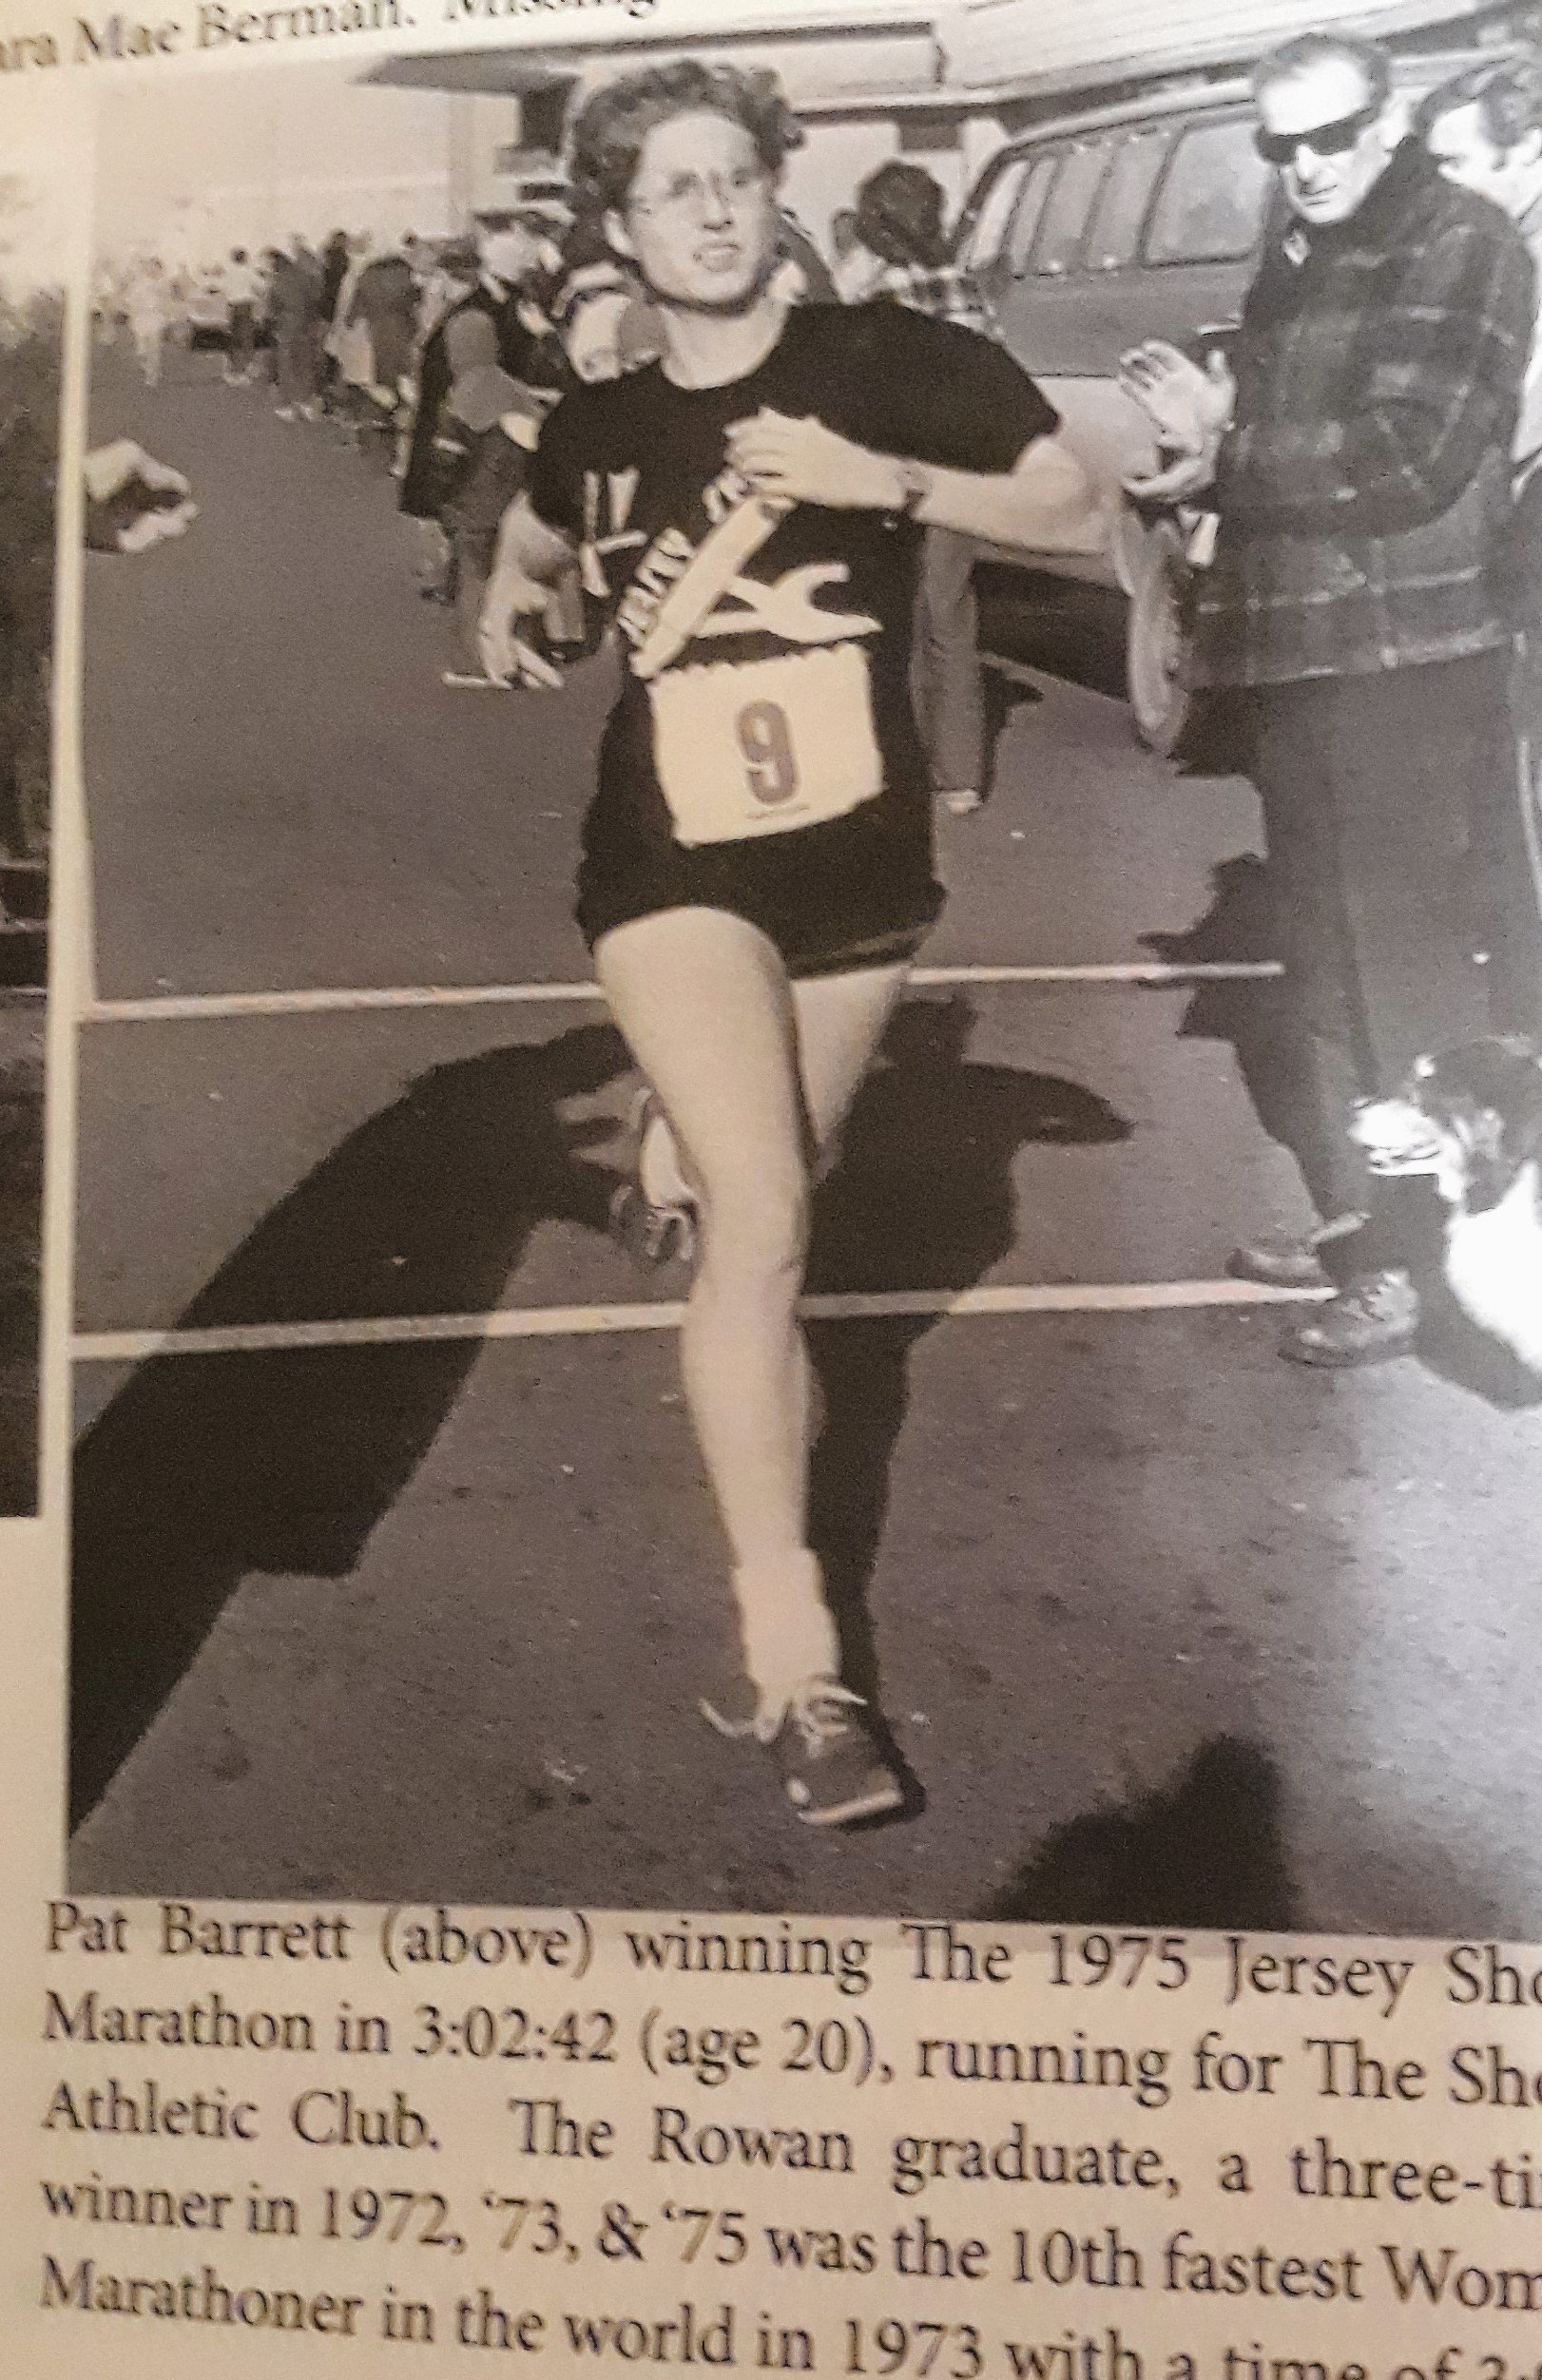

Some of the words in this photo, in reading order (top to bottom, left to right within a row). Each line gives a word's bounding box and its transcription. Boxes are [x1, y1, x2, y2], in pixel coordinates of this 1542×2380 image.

[193, 0, 417, 50] Berman.
[734, 701, 801, 806] 9
[45, 1902, 128, 1955] Pat
[159, 1902, 354, 1962] Barrett
[380, 1910, 594, 1979] (above)
[624, 1919, 873, 1998] winning
[901, 1923, 1014, 1985] The
[1048, 1934, 1190, 1992] 1975
[1224, 1936, 1416, 2020] Jersey
[41, 1988, 317, 2052] Marathon
[336, 2001, 392, 2056] in
[412, 2004, 618, 2063] 3:02:42
[639, 2006, 761, 2088] (age
[781, 2014, 896, 2088] 20),
[916, 2029, 1172, 2110] running
[1191, 2029, 1284, 2096] for
[1302, 2037, 1428, 2102] The
[1448, 2044, 1542, 2109] Sh
[40, 2078, 260, 2142] Athletic
[289, 2088, 441, 2152] Club.
[507, 2098, 616, 2160] The
[648, 2104, 856, 2174] Rowan
[890, 2121, 1182, 2199] graduate,
[1217, 2152, 1254, 2195] a
[1288, 2135, 1542, 2211] three-ti
[39, 2171, 235, 2232] winner
[246, 2180, 300, 2237] in
[320, 2186, 467, 2255] 1972,
[595, 2200, 650, 2262] &
[762, 2226, 878, 2275] was
[891, 2215, 991, 2281] the
[1012, 2225, 1147, 2291] 10th
[1162, 2228, 1364, 2302] fastest
[39, 2254, 365, 2337] Marathoner
[380, 2284, 435, 2345] in
[454, 2287, 547, 2353] the
[561, 2301, 738, 2368] world
[756, 2311, 816, 2372] in
[844, 2317, 985, 2380] 1973
[1003, 2326, 1144, 2380] with
